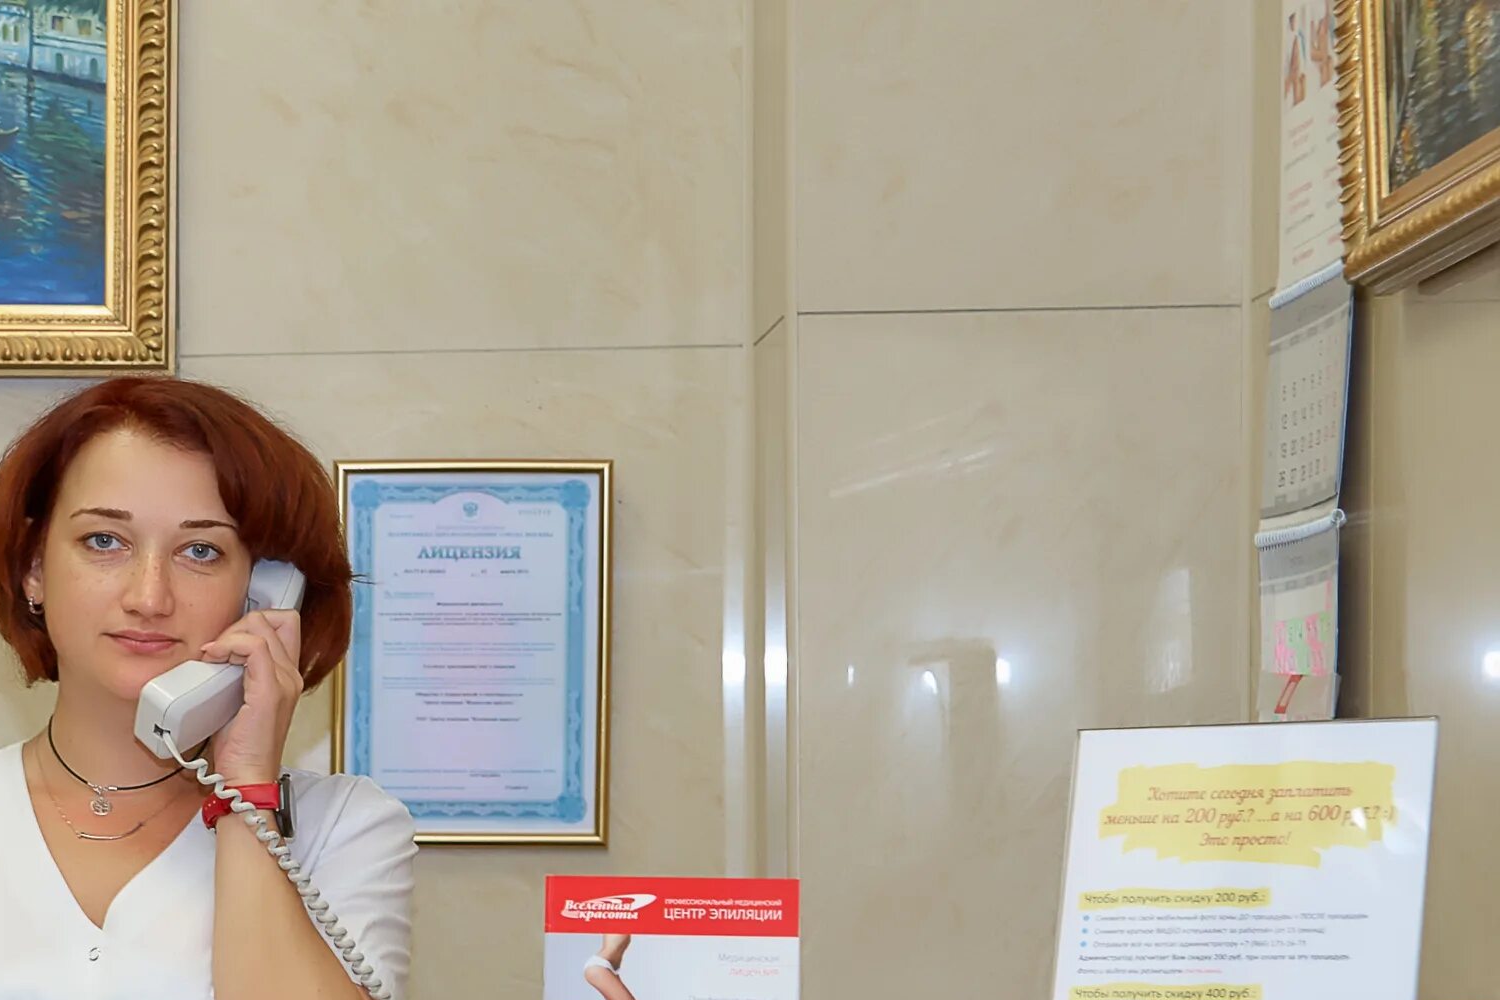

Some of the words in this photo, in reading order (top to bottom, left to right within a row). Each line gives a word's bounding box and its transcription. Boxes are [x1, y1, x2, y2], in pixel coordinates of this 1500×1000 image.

[417, 546, 522, 562] ЛИЦЕНЗИЯ
[1147, 786, 1207, 801] Хотите
[1210, 789, 1265, 805] сегодня
[1161, 813, 1180, 824] на
[1184, 807, 1217, 824] 200
[1284, 812, 1302, 822] на
[1308, 805, 1341, 822] 600
[1199, 832, 1229, 846] Это
[1232, 831, 1292, 852] просто!
[565, 899, 632, 911] Вселенная
[1084, 892, 1115, 904] Чтобы
[1121, 893, 1171, 905] получить
[1173, 892, 1212, 904] скидку
[1215, 891, 1235, 902] 200
[579, 911, 638, 921] красоты
[664, 908, 707, 921] ЦЕНТР
[709, 908, 783, 922] ЭПИЛЯЦИИ
[1076, 988, 1109, 999] Чтобы
[1112, 989, 1163, 1000] получить
[1165, 989, 1203, 1000] скидку
[1206, 988, 1226, 998] 400
